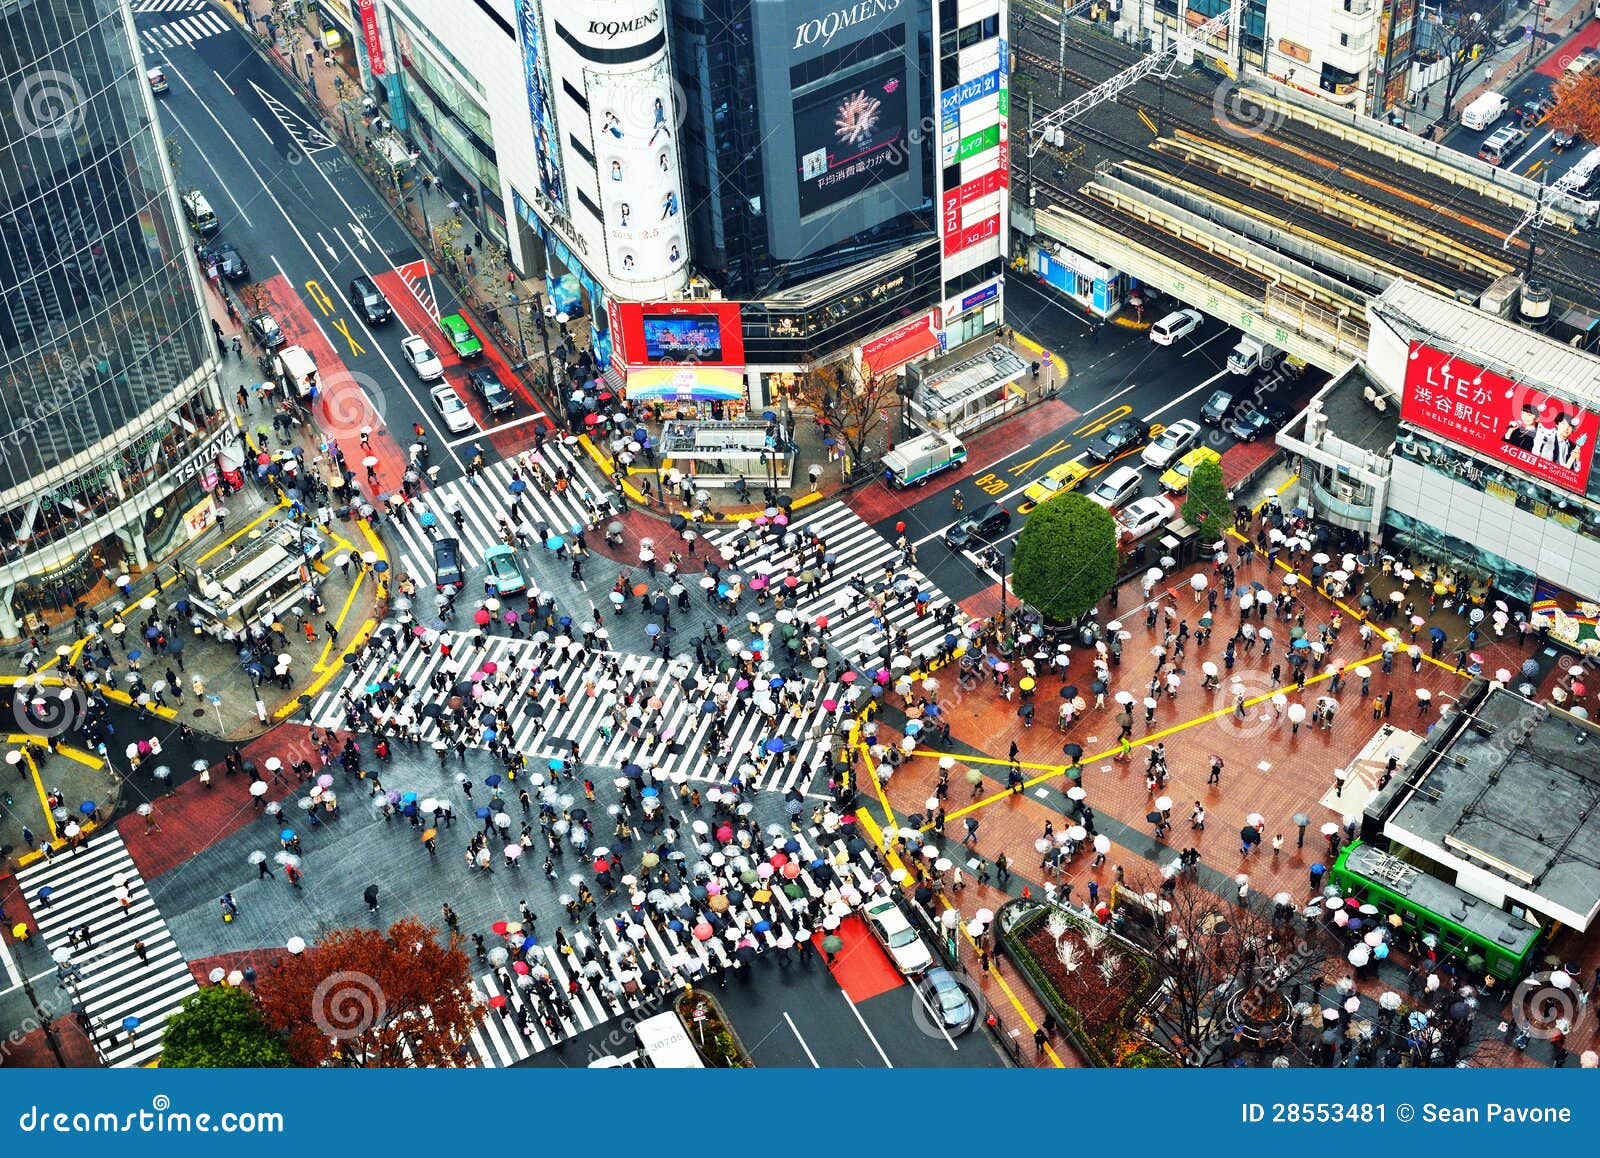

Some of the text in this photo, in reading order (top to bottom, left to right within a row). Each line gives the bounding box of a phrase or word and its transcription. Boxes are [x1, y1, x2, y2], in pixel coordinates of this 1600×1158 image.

[946, 198, 958, 232] アコム
[1427, 366, 1493, 405] LTEが
[176, 430, 233, 486] TSUTAYA
[1434, 453, 1485, 485] 渋谷駅
[1500, 444, 1537, 466] 4G LTE
[975, 473, 1009, 495] 8-20
[1549, 465, 1578, 484] SoftBank
